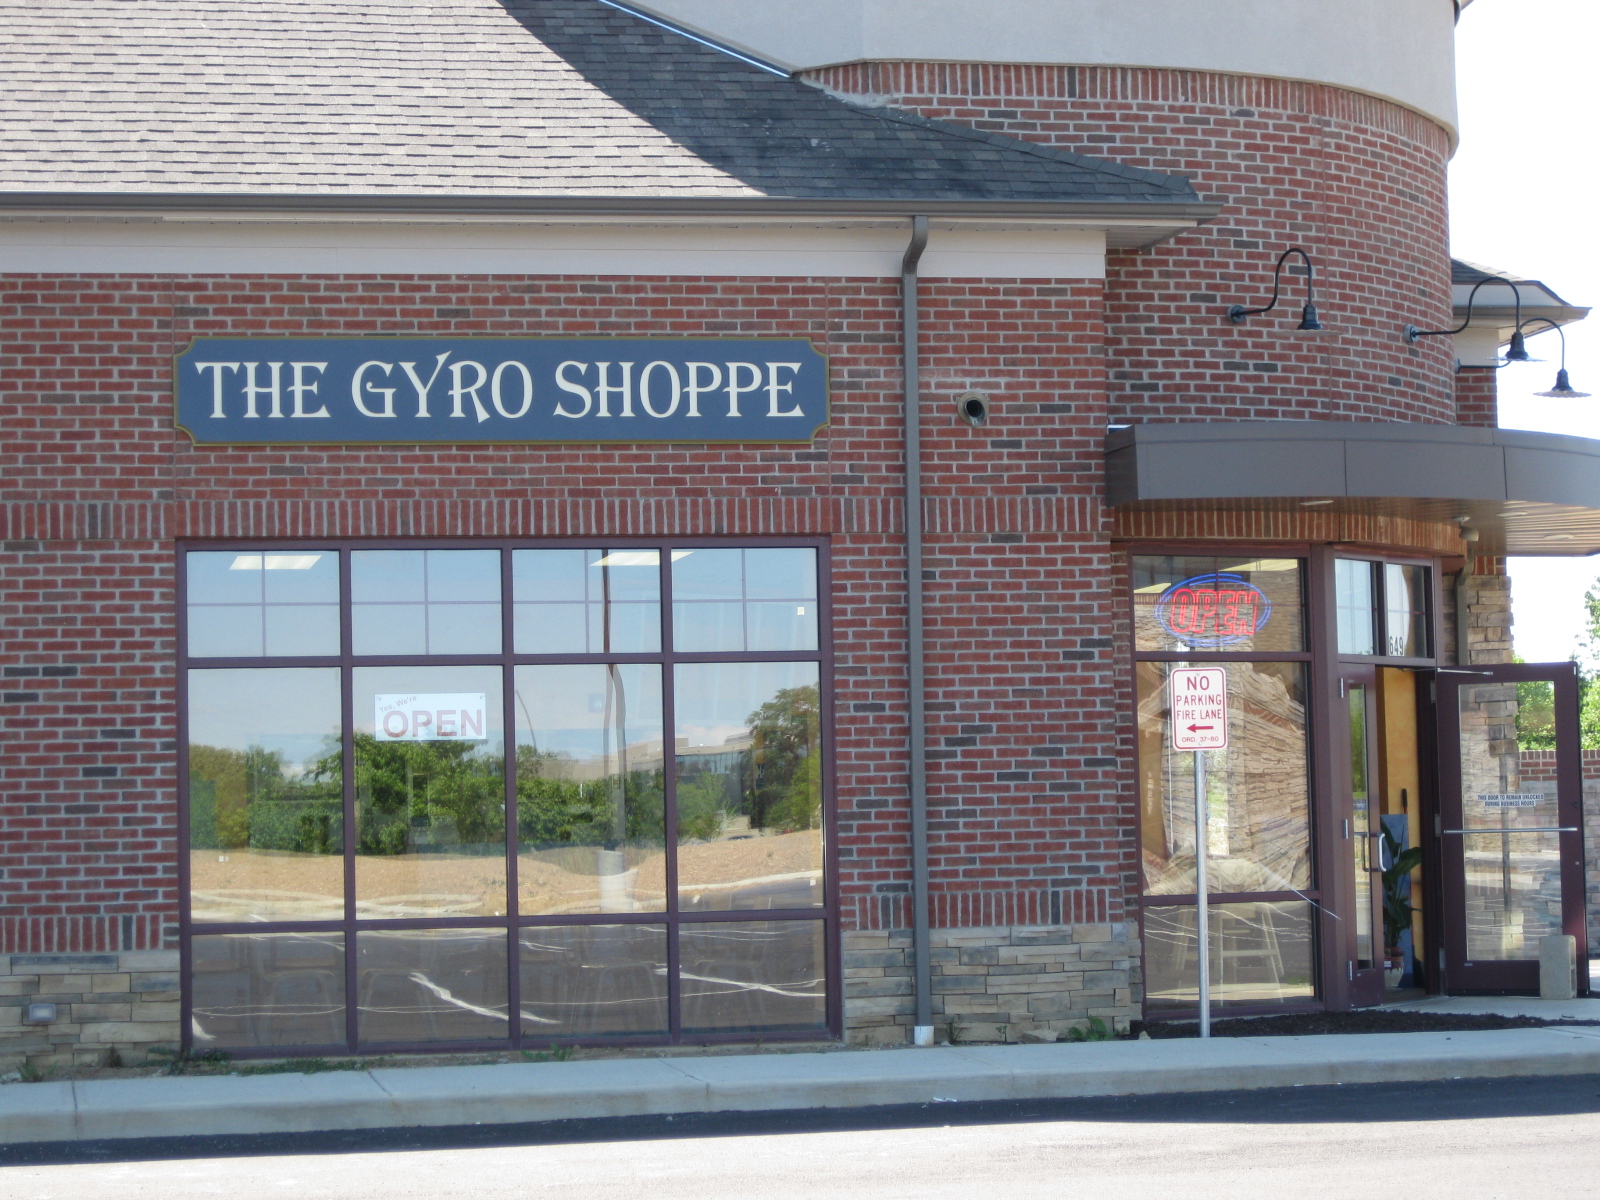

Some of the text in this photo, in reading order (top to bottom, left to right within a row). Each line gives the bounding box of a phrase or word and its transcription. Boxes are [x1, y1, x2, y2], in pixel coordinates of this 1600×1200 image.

[194, 350, 805, 424] THE GYRO SHOPPE
[1169, 588, 1259, 635] OPEN
[1389, 635, 1404, 656] 649
[1186, 675, 1210, 691] NO
[379, 696, 417, 713] Yes, We're
[1176, 694, 1222, 706] PARKING
[383, 709, 483, 738] OPEN
[1176, 709, 1222, 720] FIRE LANE
